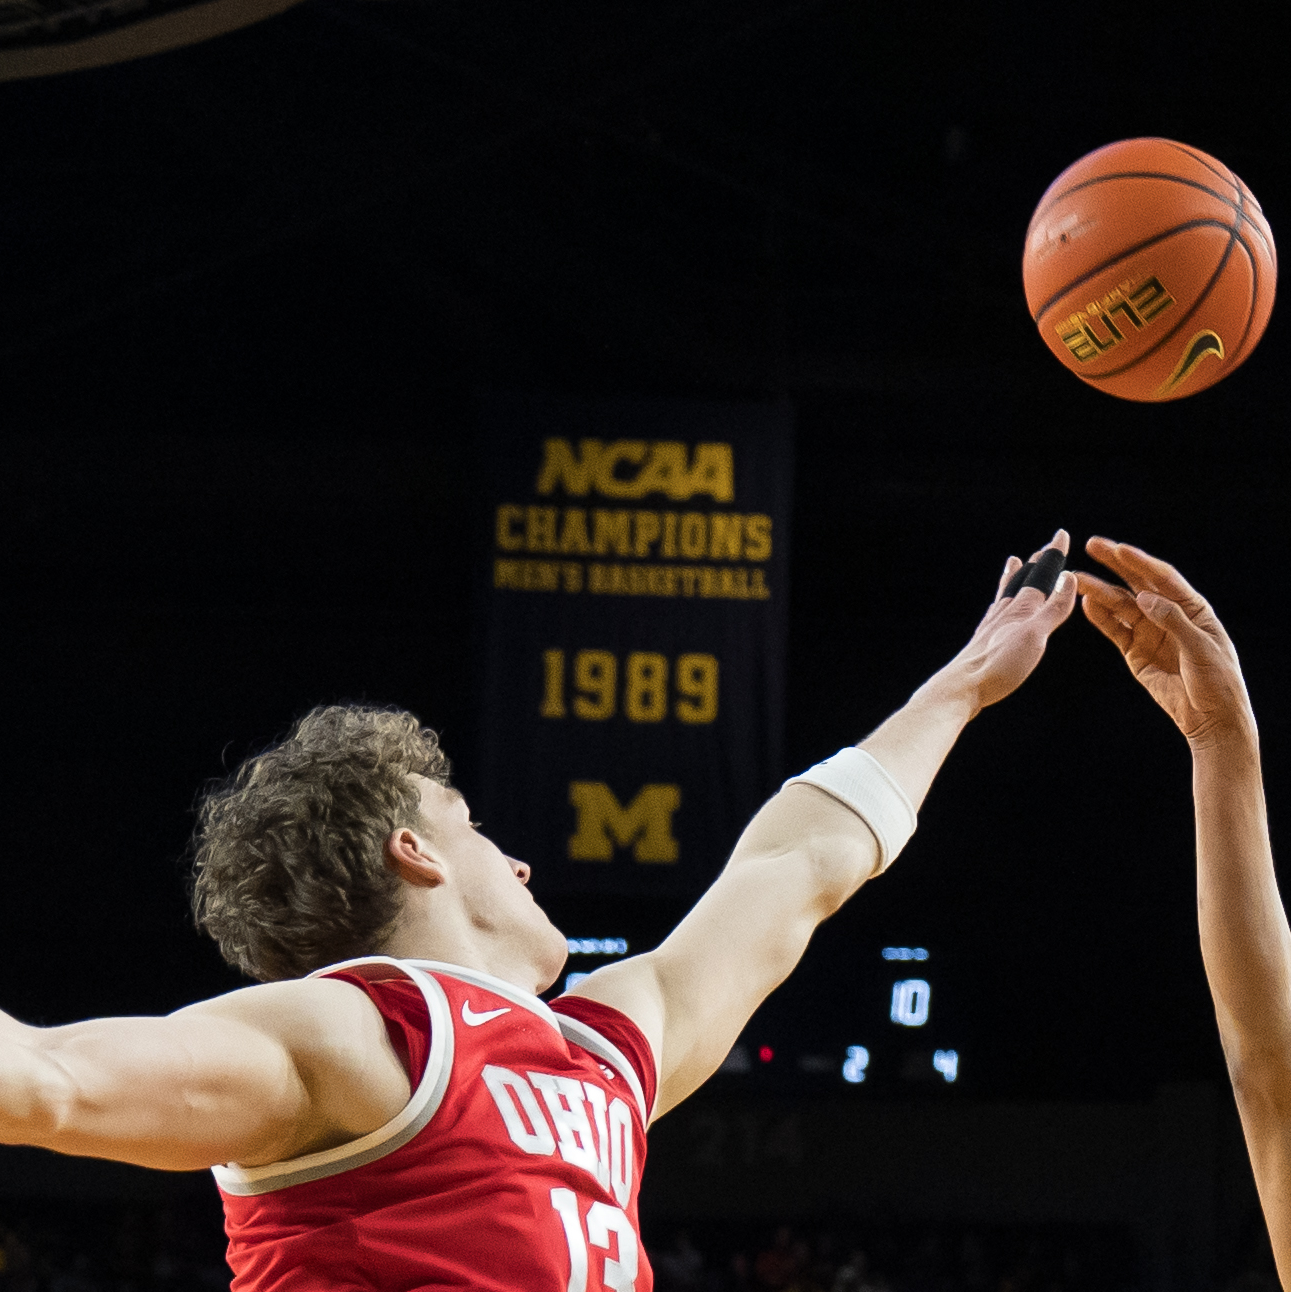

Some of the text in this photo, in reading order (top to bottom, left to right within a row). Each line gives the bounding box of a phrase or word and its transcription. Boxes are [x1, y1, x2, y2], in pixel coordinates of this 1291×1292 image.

[537, 439, 734, 502] NCAA
[496, 505, 772, 561] CHAMPIONS
[494, 561, 769, 599] MEN'S BASKETBALL
[542, 650, 720, 724] 1989
[569, 782, 680, 864] M
[481, 1065, 632, 1209] OHIO
